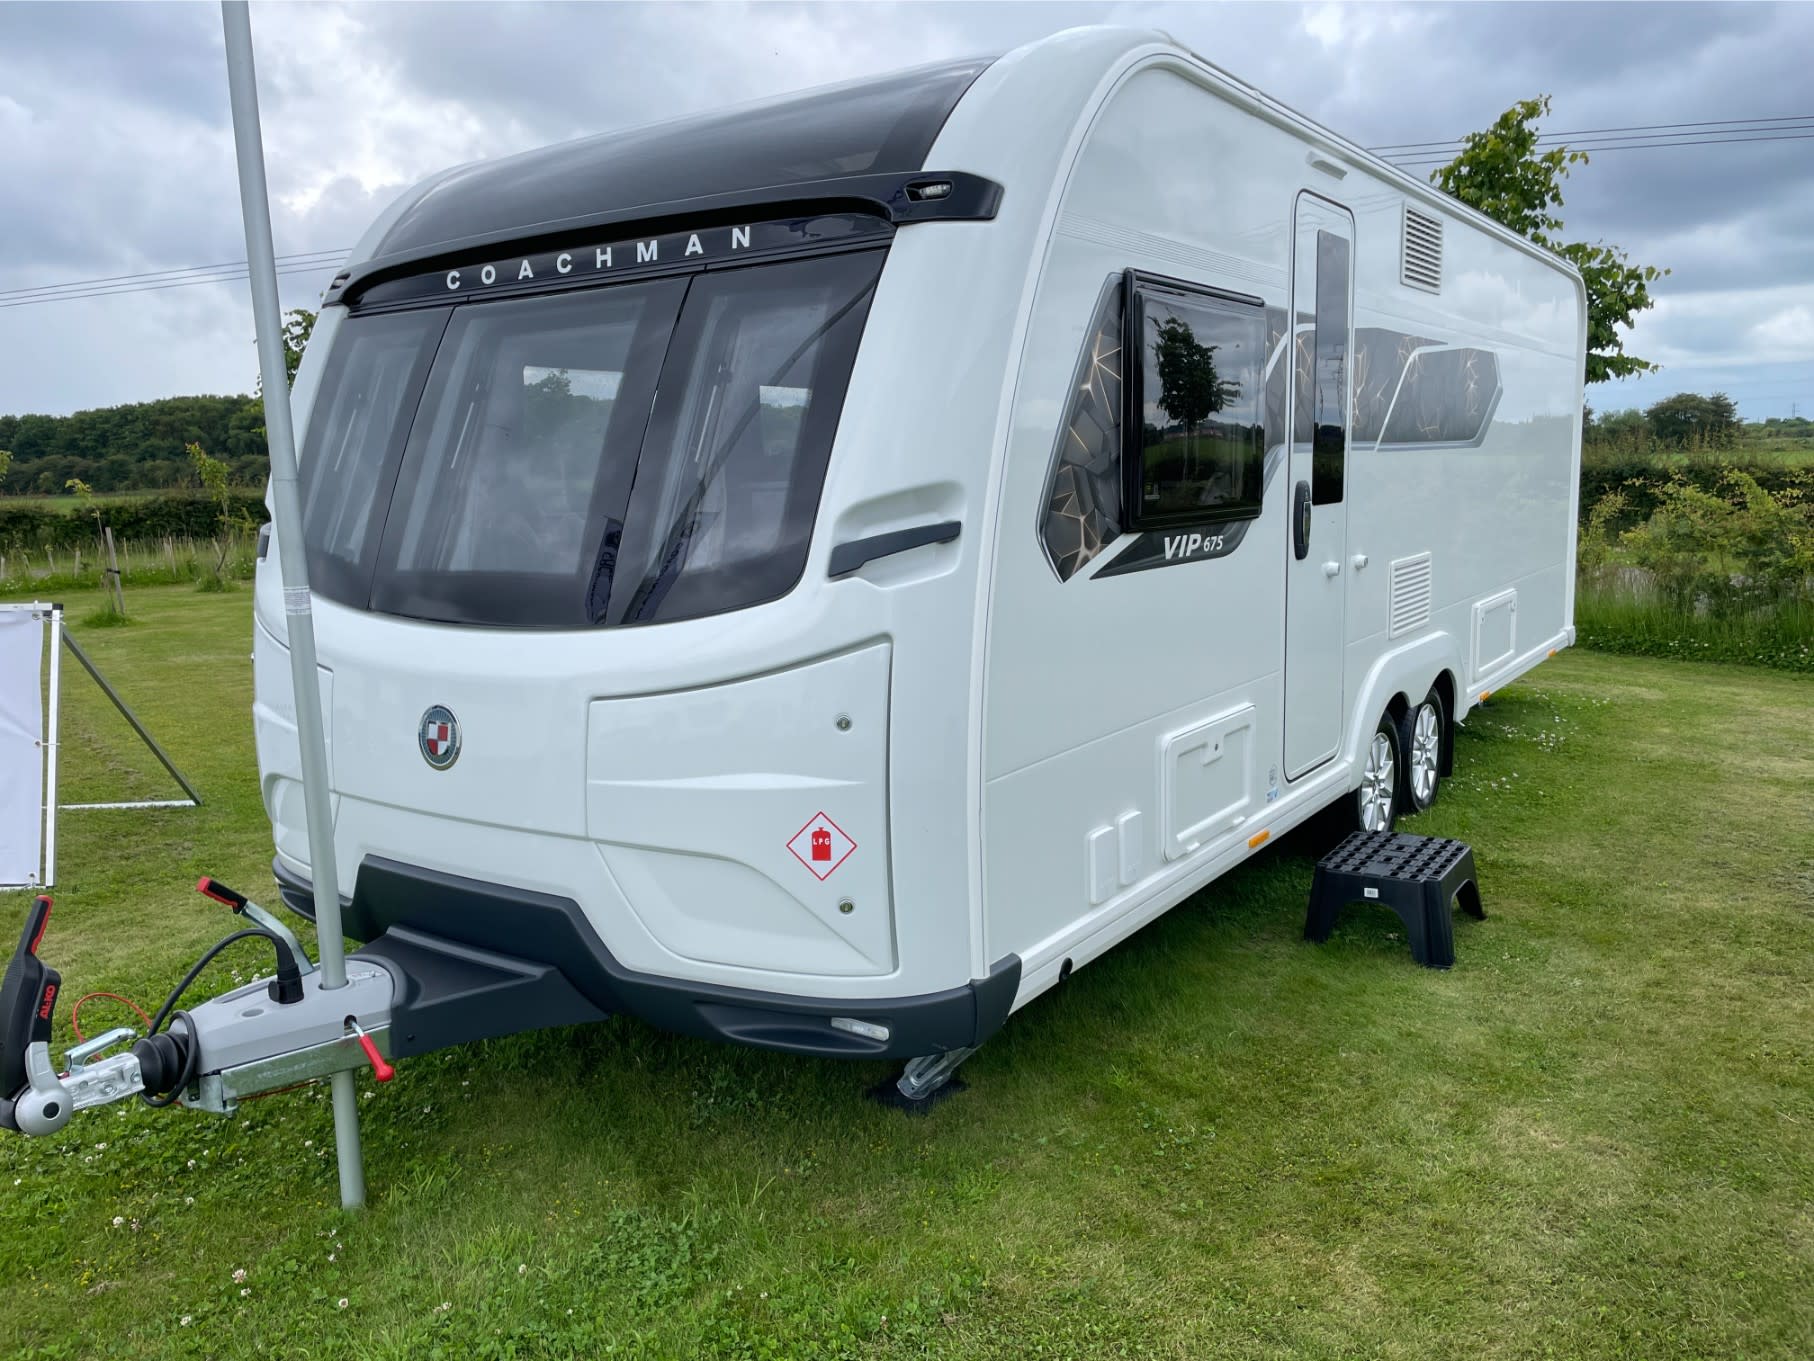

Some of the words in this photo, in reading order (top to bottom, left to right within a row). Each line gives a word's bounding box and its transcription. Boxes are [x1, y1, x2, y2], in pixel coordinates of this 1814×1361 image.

[446, 226, 750, 290] COACHMAN
[1164, 533, 1202, 560] VIP
[1203, 535, 1224, 552] 675
[812, 838, 830, 846] LPG
